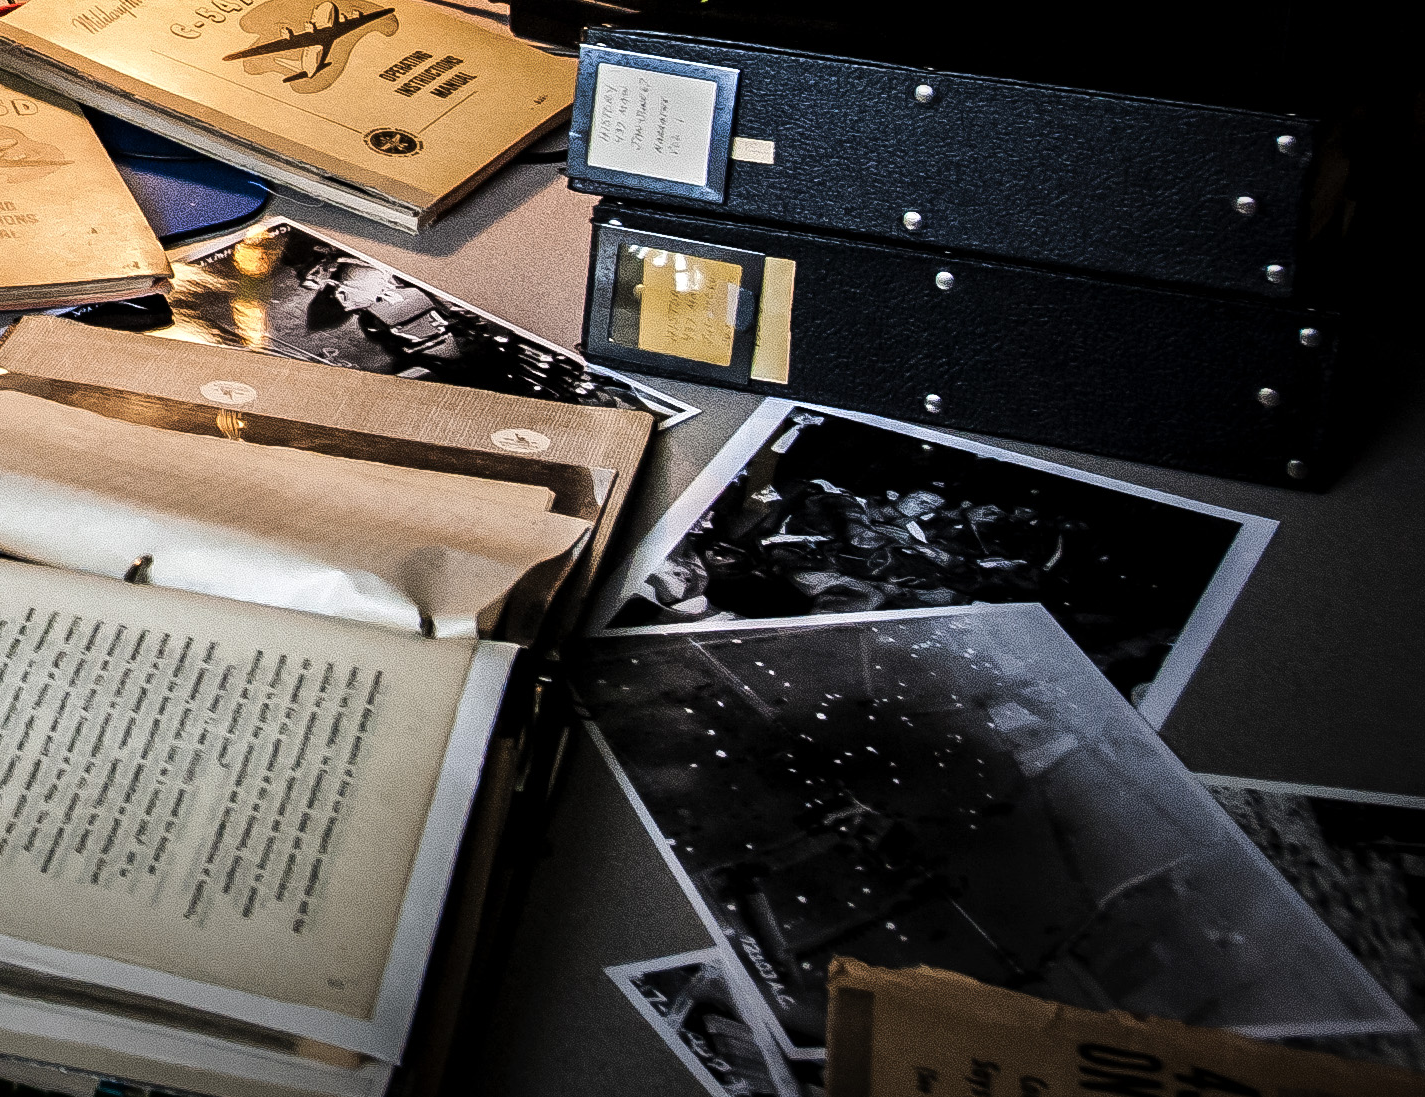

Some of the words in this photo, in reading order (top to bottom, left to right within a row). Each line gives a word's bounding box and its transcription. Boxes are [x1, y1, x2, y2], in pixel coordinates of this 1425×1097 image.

[72, 5, 137, 34] Military
[378, 50, 433, 82] OPERATING
[394, 55, 464, 98] INSTRUCTIONS
[430, 71, 478, 99] MANUAL
